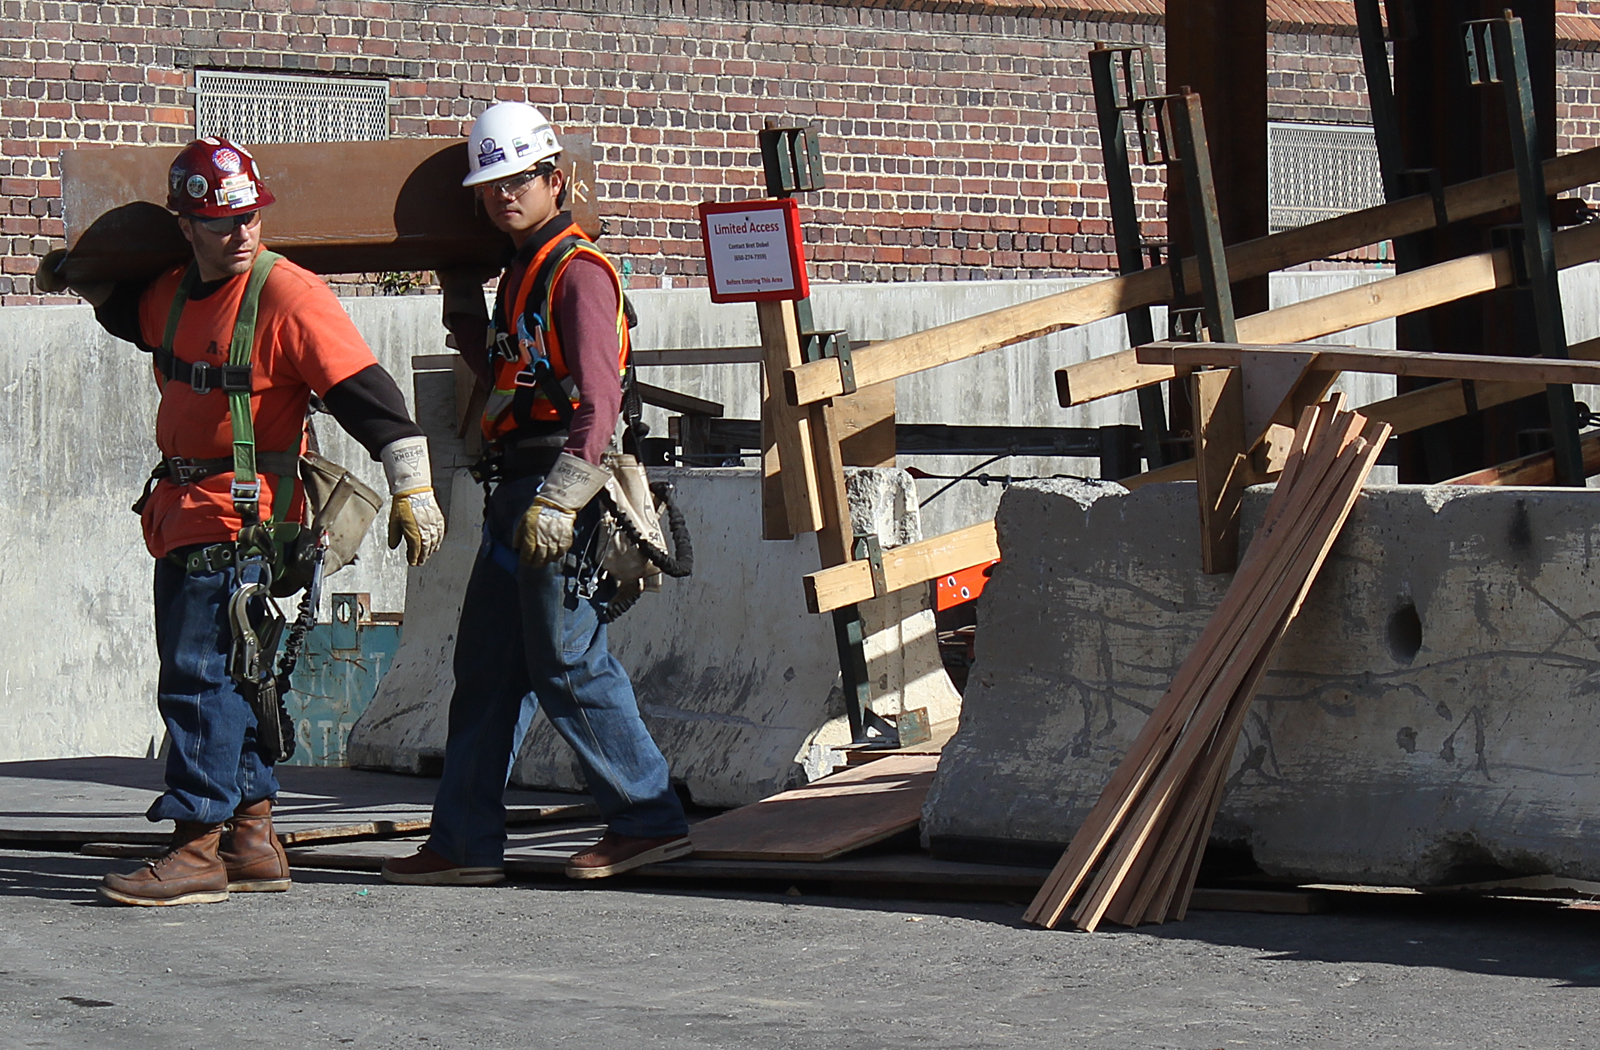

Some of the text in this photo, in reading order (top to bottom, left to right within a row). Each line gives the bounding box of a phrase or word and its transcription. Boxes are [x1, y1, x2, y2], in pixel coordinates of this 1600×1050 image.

[714, 222, 780, 235] Limited Access
[726, 278, 741, 286] Before
